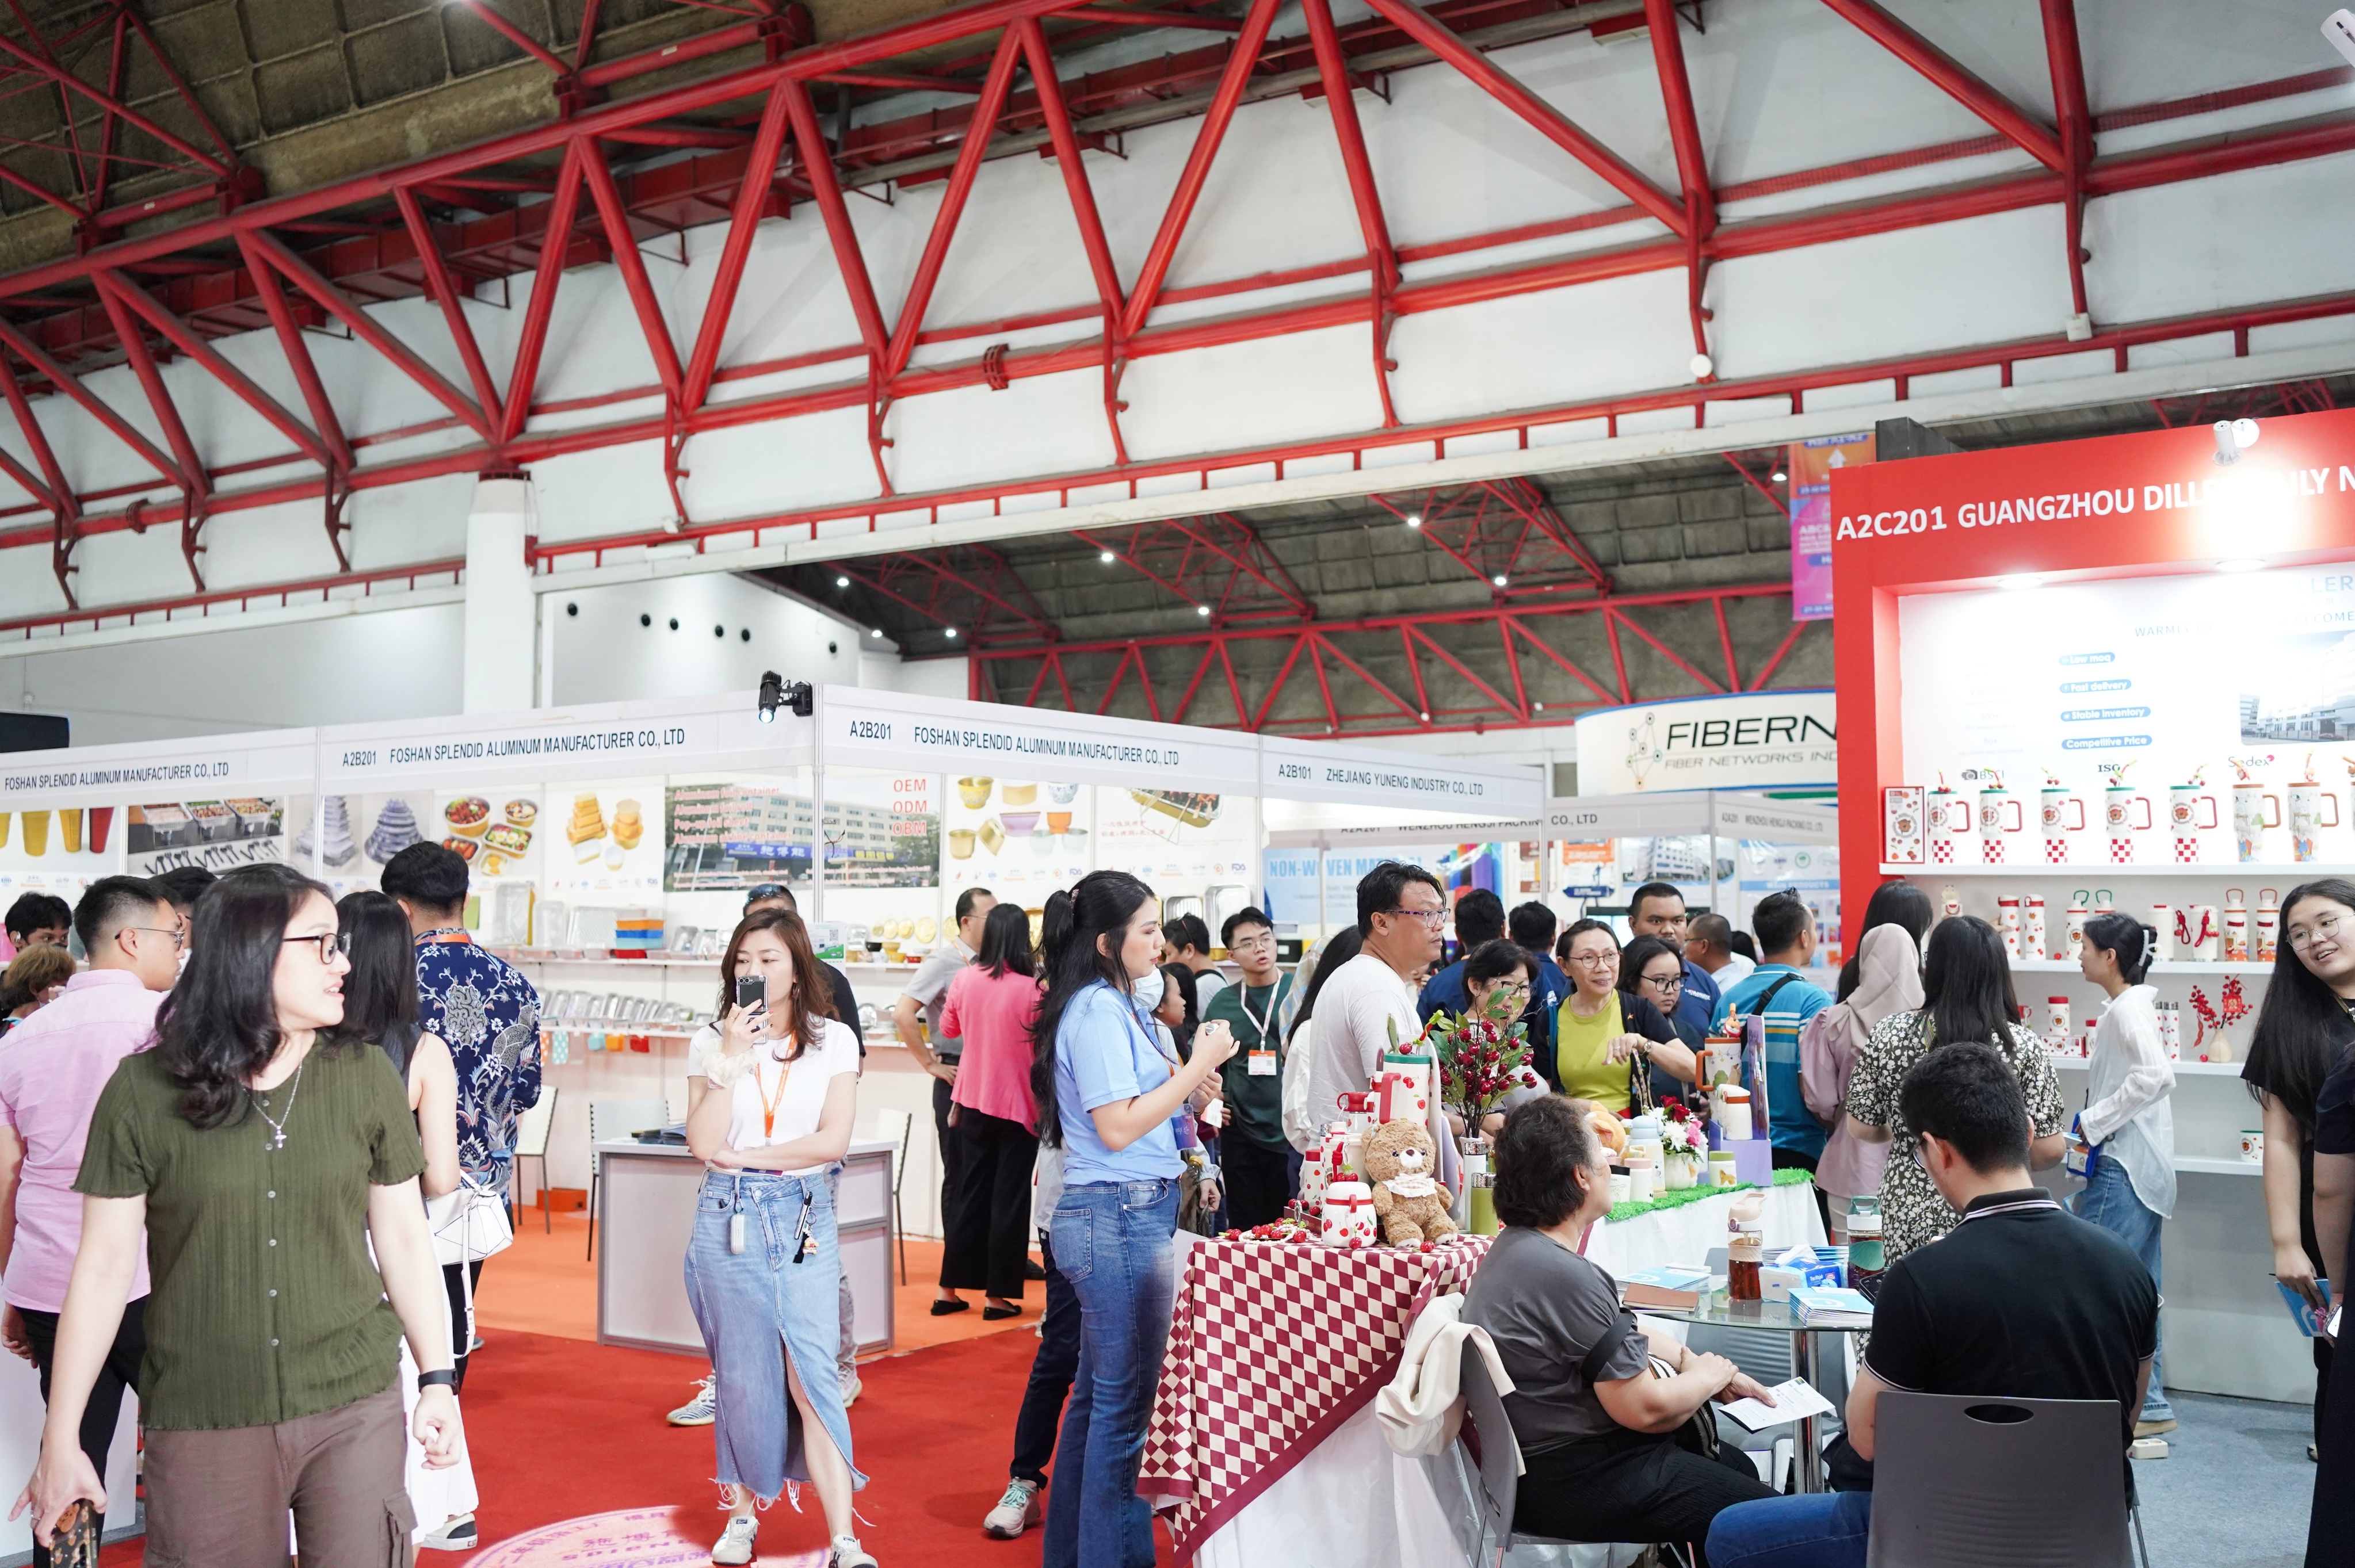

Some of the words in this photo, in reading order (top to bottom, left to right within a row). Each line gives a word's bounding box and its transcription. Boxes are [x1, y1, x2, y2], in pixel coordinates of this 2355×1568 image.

[1836, 506, 1947, 541] A2C201
[1958, 488, 2134, 528] GUANGZHOU
[2144, 481, 2220, 511] DILLE
[2070, 655, 2088, 664] Low
[2089, 653, 2111, 662] moq
[2071, 683, 2089, 692] Fast
[2090, 681, 2127, 690] delivery
[2072, 711, 2100, 720] Stable
[343, 751, 376, 767] A2B201
[390, 746, 431, 763] FOSHAN
[434, 743, 483, 760] SPLENDID
[487, 739, 540, 756] ALUMINUM
[544, 731, 634, 753] MANUFACTURER
[639, 731, 661, 749] CO.,
[664, 728, 685, 745] LTD
[850, 720, 891, 740] A2B201
[915, 726, 959, 746] FOSHAN
[963, 731, 1012, 751] SPLENDID
[1016, 737, 1066, 756] ALUMINUM
[1069, 742, 1142, 763] MANUFACTURER
[1146, 749, 1162, 766] CO.,
[1164, 751, 1179, 765] LTD
[2066, 739, 2121, 748] Competitive
[2124, 736, 2147, 745] Price
[1665, 757, 1704, 770] FIBER
[1709, 751, 1804, 766] NETWORKS
[5, 775, 37, 791] FOSHAN
[39, 772, 77, 789] SPLENDID
[79, 770, 121, 786] ALUMINUM
[123, 764, 191, 783] MANUFACTURER
[194, 763, 211, 779] CO.,
[213, 762, 228, 777] LTD
[1278, 764, 1311, 779] A2B101
[1326, 768, 1371, 785] ZHEJIANG
[1374, 772, 1409, 789] YUNENG
[1411, 777, 1449, 793] INDUSTRY
[1453, 782, 1468, 796] CO.,
[1470, 783, 1483, 796] LTD
[894, 779, 926, 792] OEM
[675, 789, 719, 801] Aluminum
[721, 787, 735, 798] foil
[737, 786, 779, 797] container
[675, 803, 719, 815] Aluminum
[894, 800, 927, 814] ODM
[674, 819, 707, 831] Pop-up
[724, 817, 749, 827] sheet
[1551, 815, 1573, 826] CO.,
[1577, 813, 1597, 824] LTD
[893, 822, 926, 835] OBM
[675, 833, 718, 844] Aluminum
[749, 831, 792, 843] container
[1269, 858, 1352, 877] NON-WVEN
